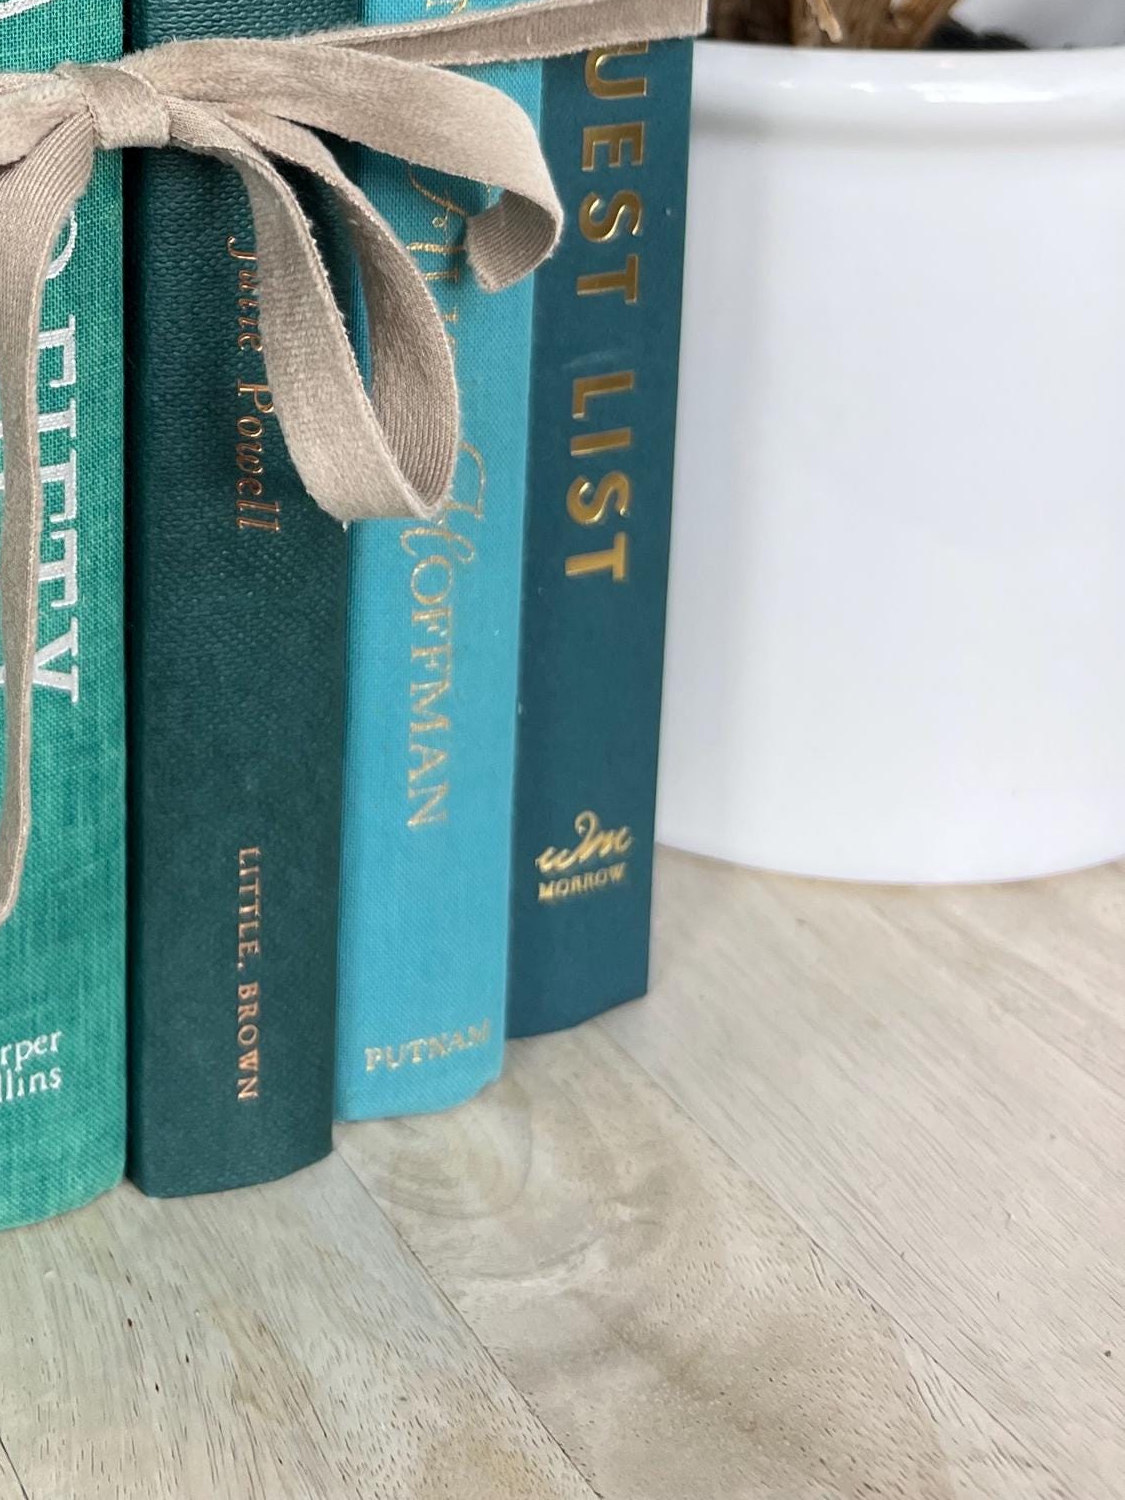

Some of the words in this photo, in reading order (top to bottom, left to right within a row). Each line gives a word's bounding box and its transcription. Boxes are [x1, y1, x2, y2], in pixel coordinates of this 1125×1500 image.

[234, 377, 280, 534] Powell
[563, 369, 636, 583] LIST
[237, 981, 261, 1102] BROWN
